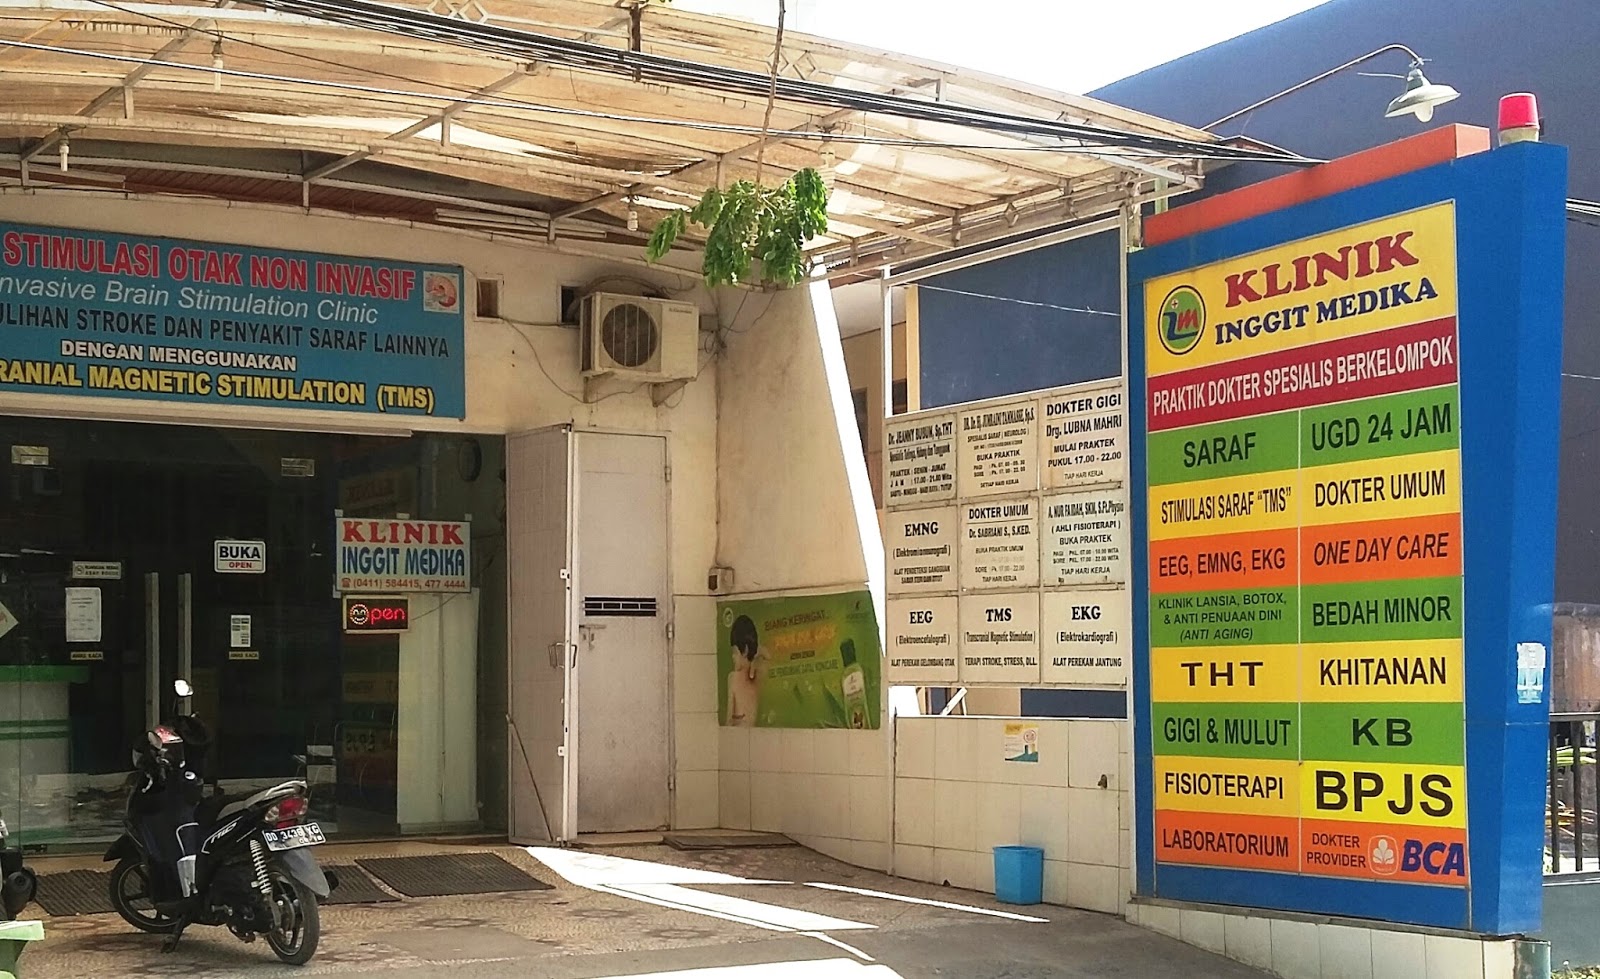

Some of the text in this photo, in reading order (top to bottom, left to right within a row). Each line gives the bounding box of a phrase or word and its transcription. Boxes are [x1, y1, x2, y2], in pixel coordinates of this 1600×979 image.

[3, 231, 415, 300] STIMULASI OTAK NON INVASIF
[1224, 231, 1420, 308] KLINIK
[0, 276, 379, 324] nvasive Brain Stimulation Clinic
[1215, 277, 1438, 345] INGGIT MEDIKA
[77, 308, 157, 336] STROKE
[164, 315, 202, 339] DAN
[210, 319, 303, 347] PENYAKIT
[309, 327, 367, 351] SARAF
[374, 333, 449, 358] LAINNYA
[61, 339, 297, 372] DENGAN MENGGUNAKAN
[1153, 335, 1454, 416] PRAKTIK DOKTER SPESIALIS BERKELOMPOK
[88, 364, 212, 395] MAGNETIC
[217, 373, 366, 405] STIMULATION
[376, 384, 435, 415] (TMS)
[1046, 393, 1121, 416] DOKTER GIGI
[1046, 414, 1122, 439] Drg. LUBNA MAHRI
[1312, 403, 1451, 451] UGD 24 JAM
[976, 449, 1020, 462] BUKA PRAKTIK
[1053, 438, 1115, 453] MULAI PRAKTEK
[1183, 432, 1256, 468] SARAF
[1047, 451, 1121, 467] PUKUL 17.00 22.00
[1075, 471, 1087, 479] HARI
[1315, 469, 1445, 508] DOKTER UMUM
[969, 504, 1029, 519] DOKTER UMUM
[1161, 495, 1216, 524] STIMULASI
[1218, 491, 1254, 519] SARAF
[343, 520, 464, 545] KLINIK
[904, 521, 939, 537] EMNG
[977, 527, 1003, 538] SABRIANI
[1059, 534, 1112, 545] BUKA PRAKTEK
[219, 546, 261, 559] BUKA
[342, 546, 465, 576] INGGIT MEDIKA
[1314, 532, 1449, 566] ONE DAY CARE
[228, 561, 253, 569] OPEN
[1090, 566, 1111, 574] KERJA
[1158, 547, 1286, 579] EEG, EMNG, EKG
[353, 578, 382, 589] (0411)
[425, 579, 441, 589] 477
[444, 579, 466, 589] 4444
[1071, 606, 1101, 620] EKG
[1158, 592, 1287, 609] KLINIK LANSIA, BOTOX,
[1313, 595, 1452, 627] BEDAH MINOR
[910, 610, 933, 624] EEG
[985, 608, 1012, 622] TMS
[1163, 609, 1282, 625] & ANTI PENUAAN DINI
[1180, 628, 1253, 643] (ANTI AGING)
[1053, 657, 1122, 667] ALAT PEREKAM JANTUNG
[1180, 661, 1264, 687] THT
[1320, 657, 1446, 686] KHITANAN
[1164, 717, 1291, 746] GIGI & MULUT
[1352, 718, 1413, 747] KB
[1165, 772, 1284, 800] FISIOTERAPI
[1315, 770, 1454, 818] BPJS
[1163, 828, 1289, 858] LABORATORIUM
[1312, 832, 1361, 849] DOKTER
[1306, 851, 1366, 868] PROVIDER
[1401, 839, 1466, 877] BCA
